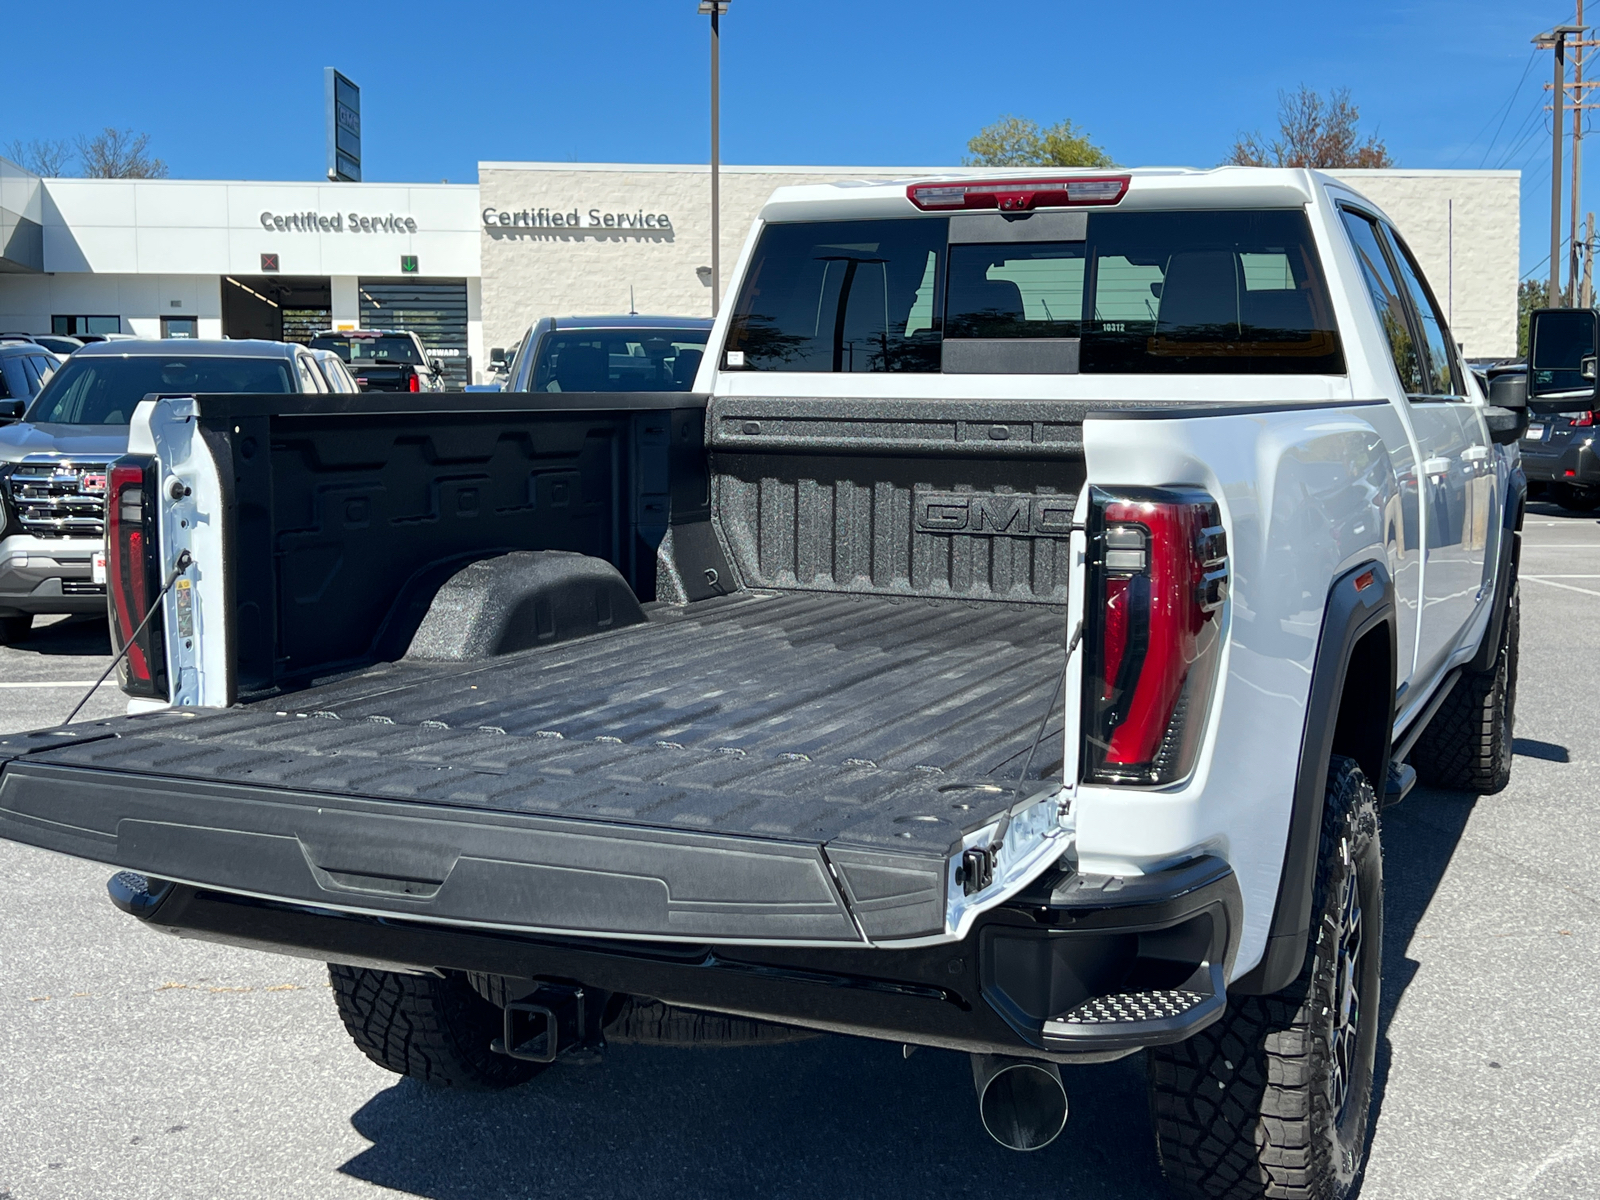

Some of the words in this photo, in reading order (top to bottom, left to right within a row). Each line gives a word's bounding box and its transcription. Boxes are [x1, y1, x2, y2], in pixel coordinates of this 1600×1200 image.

[260, 211, 343, 232] Certified
[348, 213, 417, 233] Service
[482, 207, 579, 227] Certified
[588, 209, 670, 228] Service
[1102, 323, 1125, 332] 10312
[426, 349, 460, 357] ORWARD
[917, 499, 1076, 534] GMC
